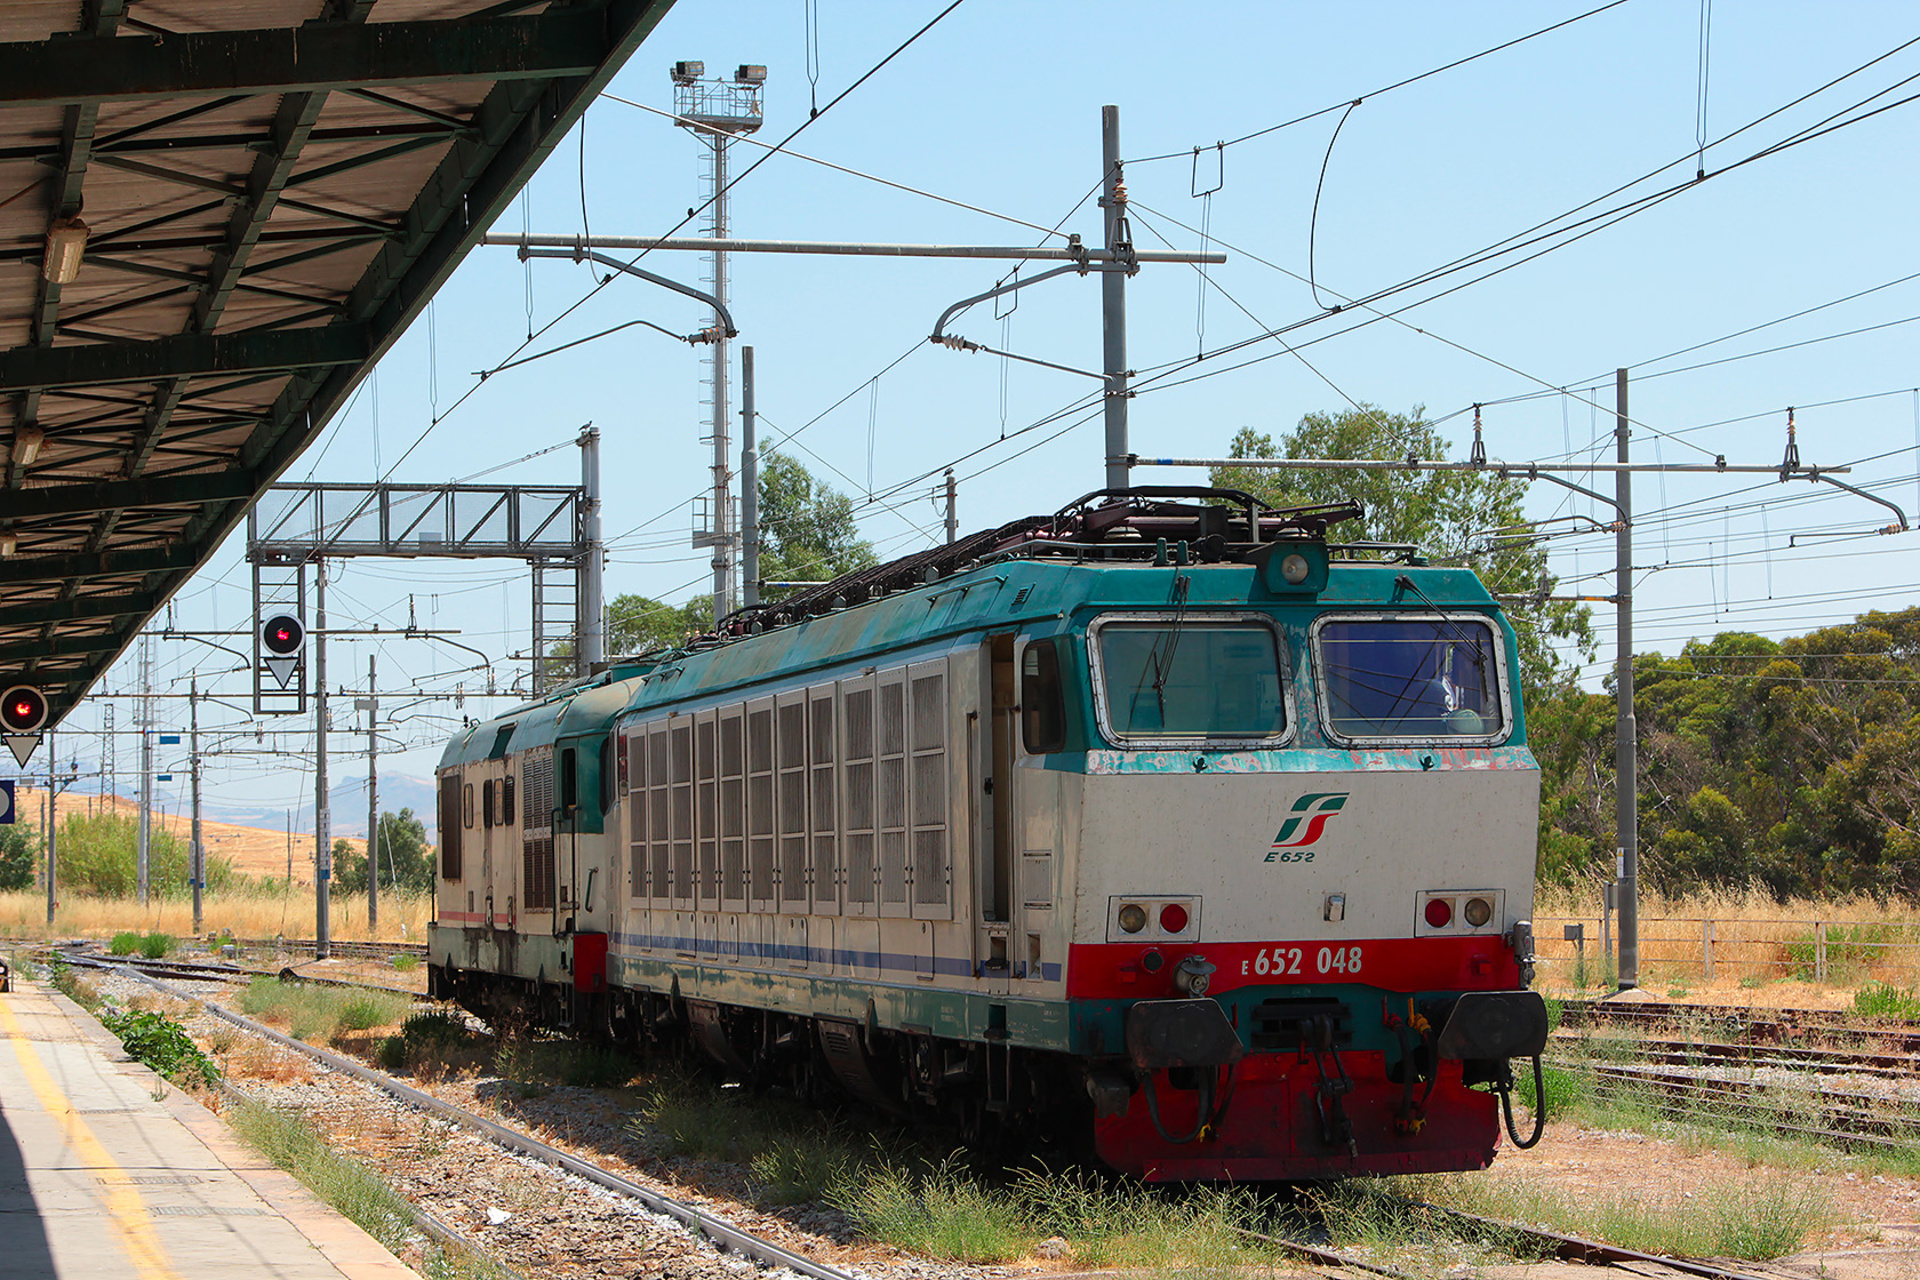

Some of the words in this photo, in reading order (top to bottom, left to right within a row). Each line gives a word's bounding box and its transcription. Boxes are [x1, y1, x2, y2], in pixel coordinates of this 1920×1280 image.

[1241, 960, 1249, 975] E
[1254, 948, 1303, 976] 652
[1316, 946, 1363, 974] 048
